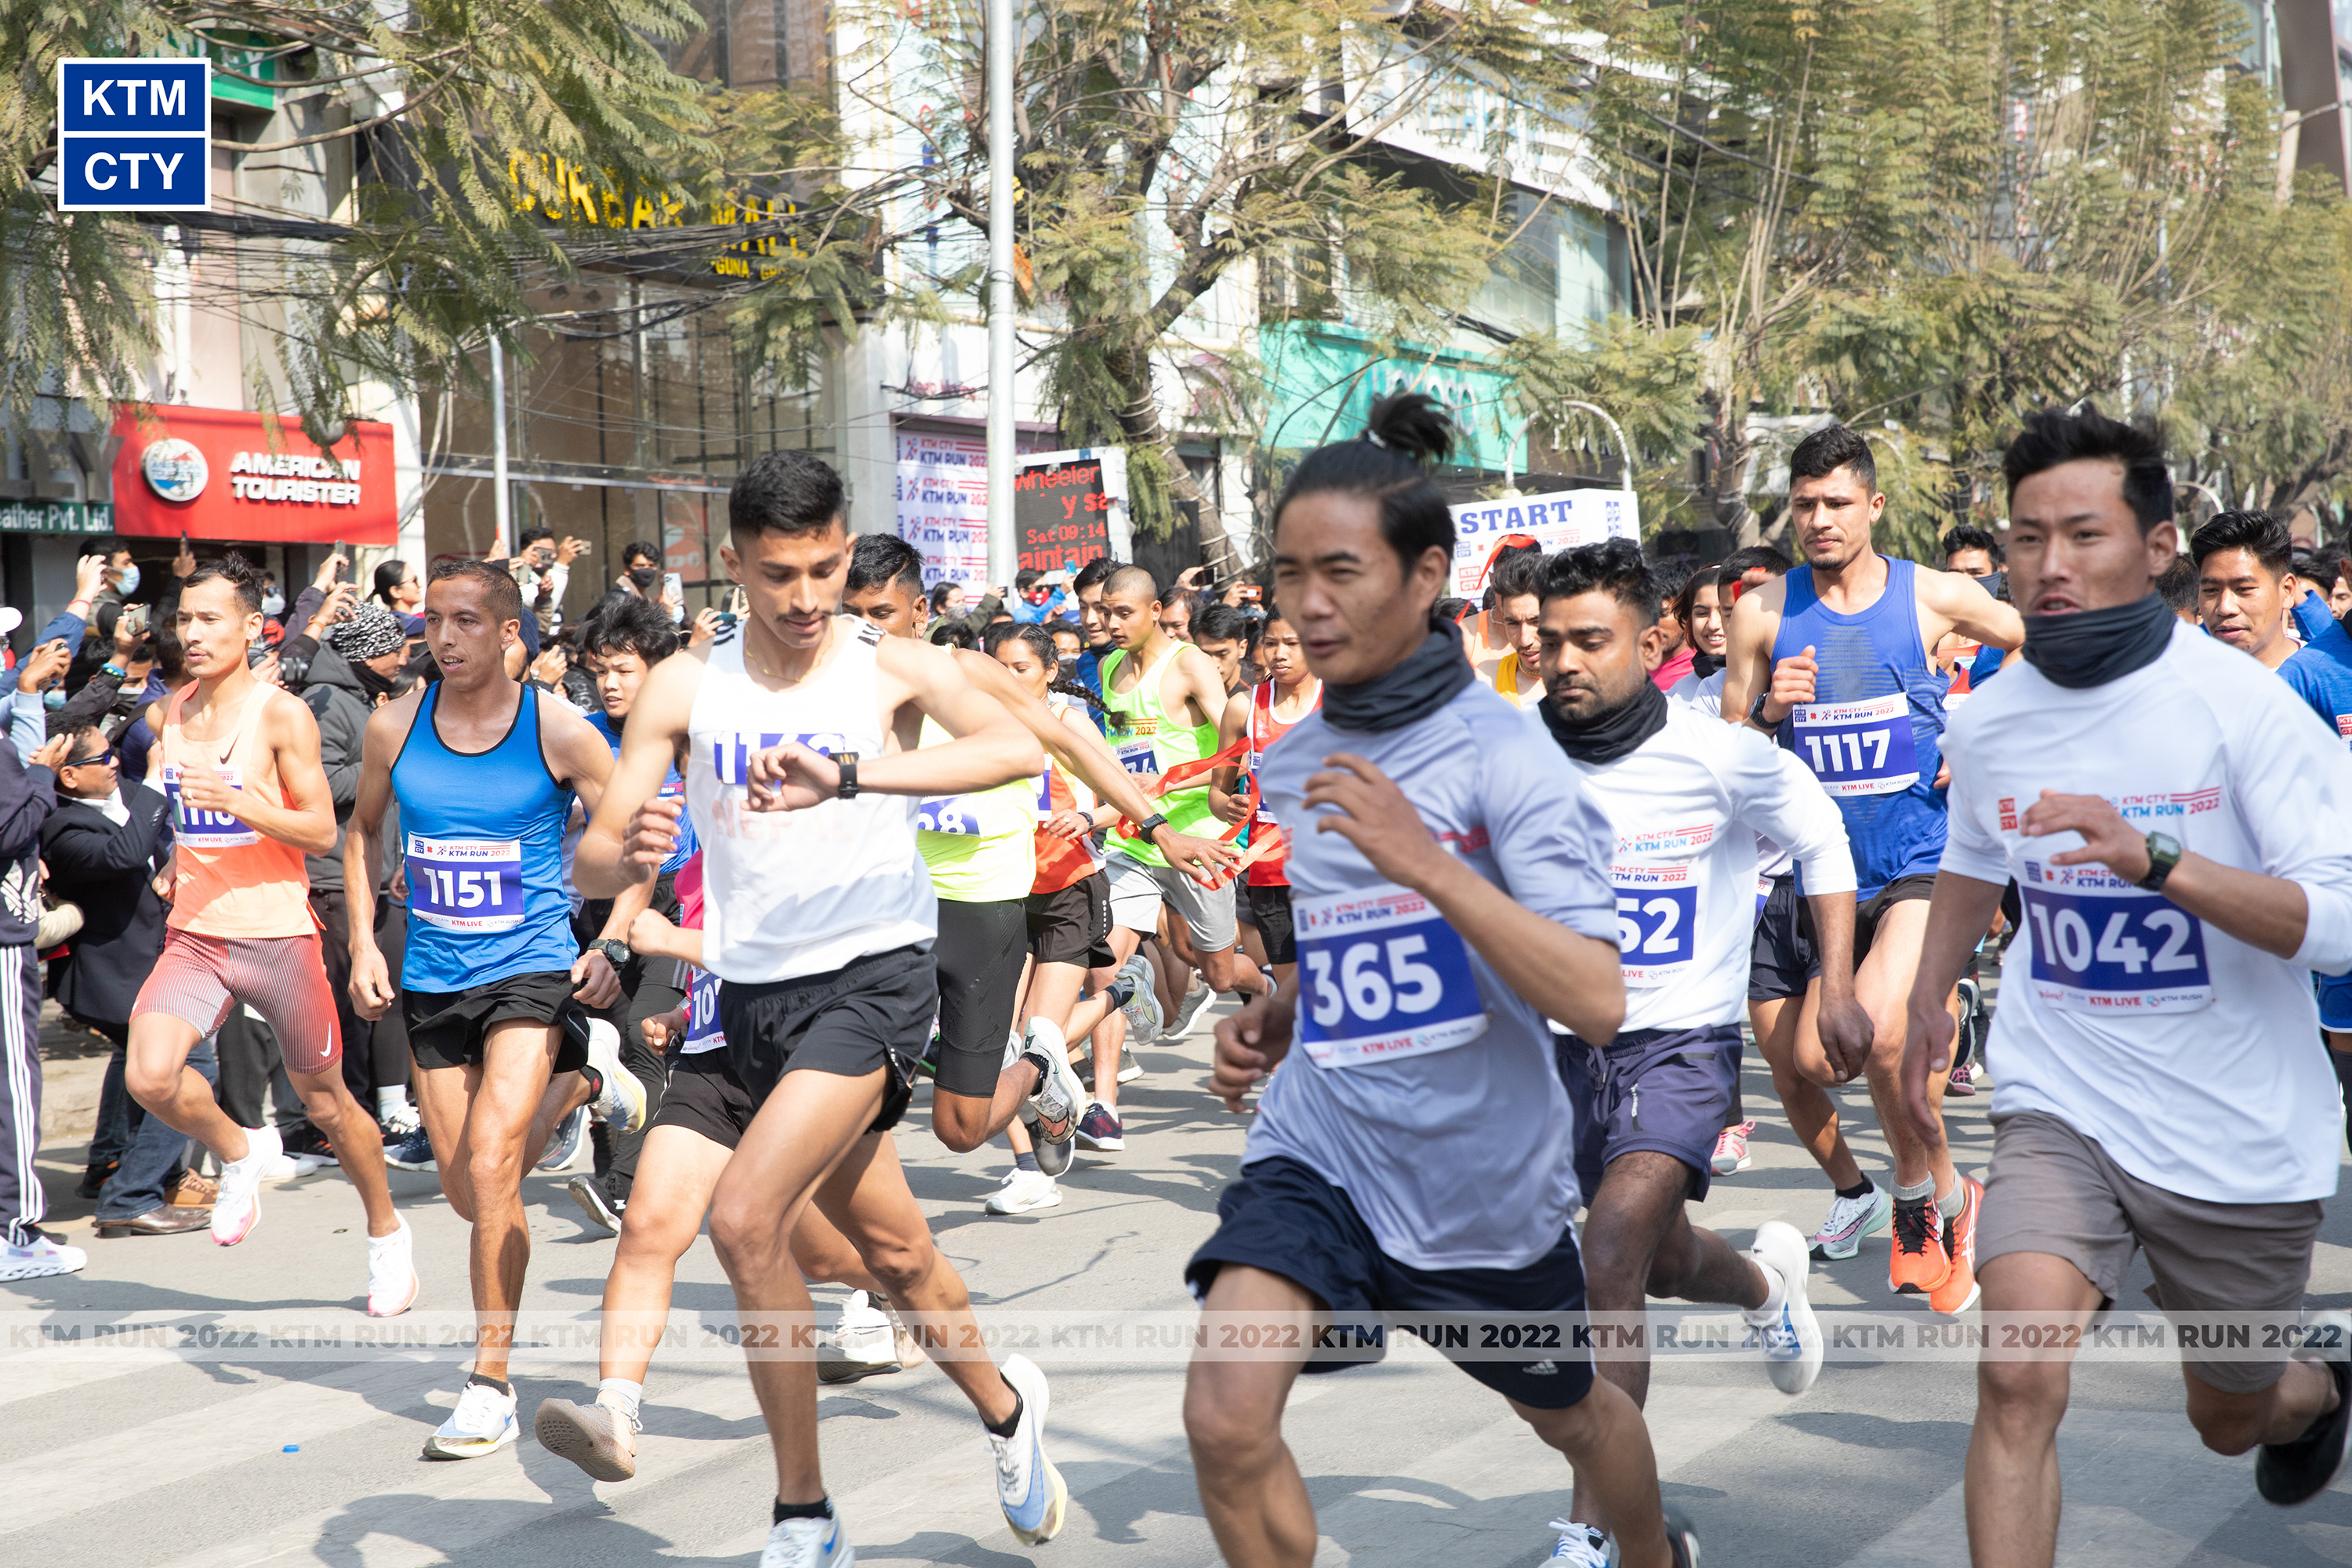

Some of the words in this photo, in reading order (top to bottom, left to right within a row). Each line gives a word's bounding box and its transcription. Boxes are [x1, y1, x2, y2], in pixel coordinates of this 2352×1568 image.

[920, 451, 942, 464] KTM
[946, 452, 967, 465] RUN
[1014, 465, 1101, 492] wheeler
[233, 477, 361, 506] TOURISTER
[922, 490, 943, 504] KTM
[947, 492, 967, 504] RUN
[0, 503, 45, 530] ather
[48, 504, 80, 531] Pvt.
[83, 505, 114, 532] Ltd.
[1460, 499, 1572, 535] START
[924, 529, 945, 543] KTM
[949, 530, 969, 543] RUN
[1026, 528, 1056, 545] Sat
[1058, 521, 1107, 542] 09:14
[1558, 535, 1581, 546] 2022
[925, 568, 946, 581] KTM
[950, 569, 970, 582] RUN
[1875, 706, 1894, 716] 2022
[1135, 726, 1156, 735] 2022
[1805, 728, 1890, 773] 1117
[2122, 797, 2144, 805] KTM
[2147, 794, 2167, 804] CTY
[2122, 804, 2151, 818] KTM
[2156, 804, 2184, 816] RUN
[2189, 797, 2220, 815] 2022
[1635, 841, 1660, 852] KTM
[1664, 838, 1686, 849] RUN
[1690, 833, 1712, 846] 2022
[1636, 832, 1654, 841] KTM
[1657, 830, 1673, 839] CTY
[1635, 874, 1659, 883] RUN
[1661, 873, 1687, 882] 2022
[2077, 878, 2104, 887] KTM
[423, 867, 503, 908] 1151
[1337, 913, 1363, 924] KTM
[1366, 907, 1392, 920] RUN
[1395, 900, 1425, 916] 2022
[1616, 897, 1680, 954] 52
[2030, 902, 2198, 974] 1042
[1305, 934, 1443, 1027] 365
[1622, 969, 1643, 978] LIVE
[2089, 996, 2112, 1006] KTM
[2115, 996, 2141, 1007] LIVE
[1362, 1042, 1385, 1054] KTM
[1388, 1037, 1413, 1051] LIVE
